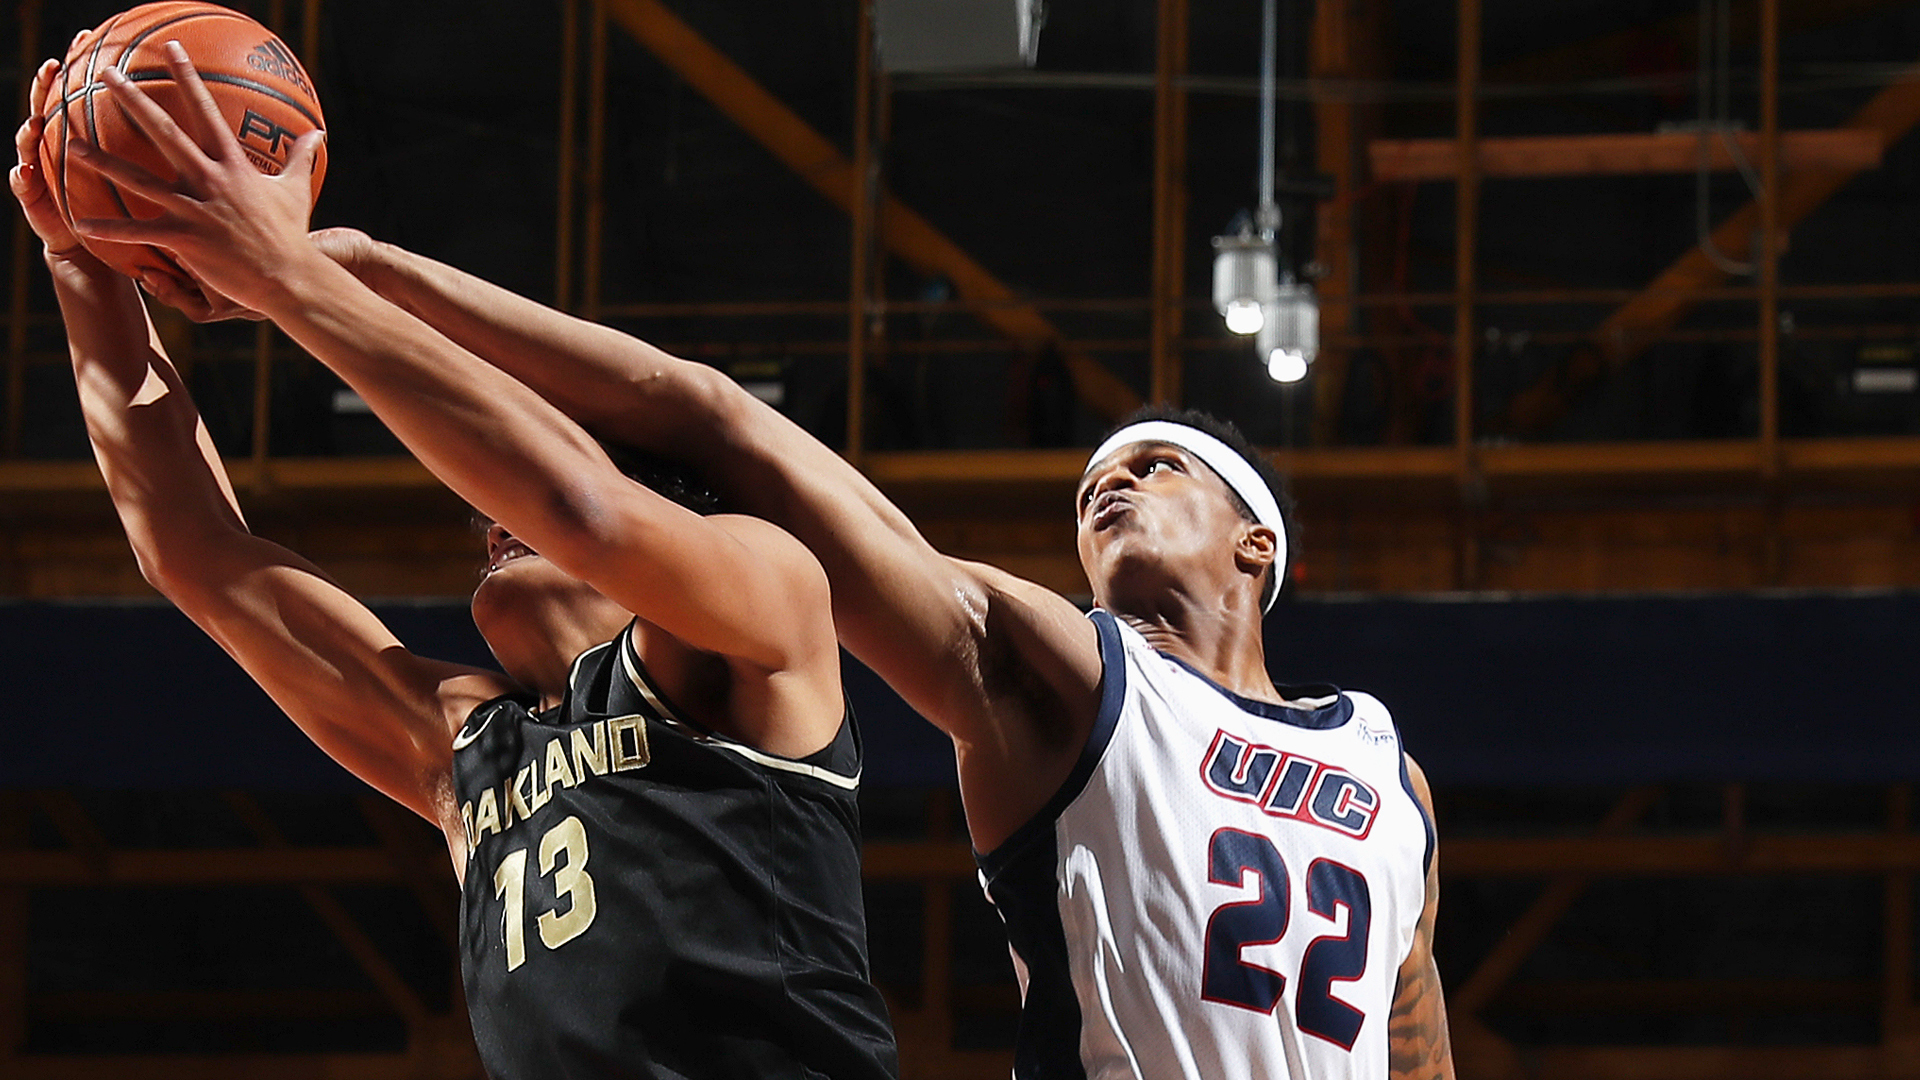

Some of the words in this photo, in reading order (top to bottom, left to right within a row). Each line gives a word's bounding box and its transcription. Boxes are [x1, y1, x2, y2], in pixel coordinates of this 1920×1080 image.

[461, 714, 650, 860] OAKLAND
[1200, 728, 1380, 841] UIC
[494, 815, 597, 972] 13
[1201, 826, 1371, 1053] 22
